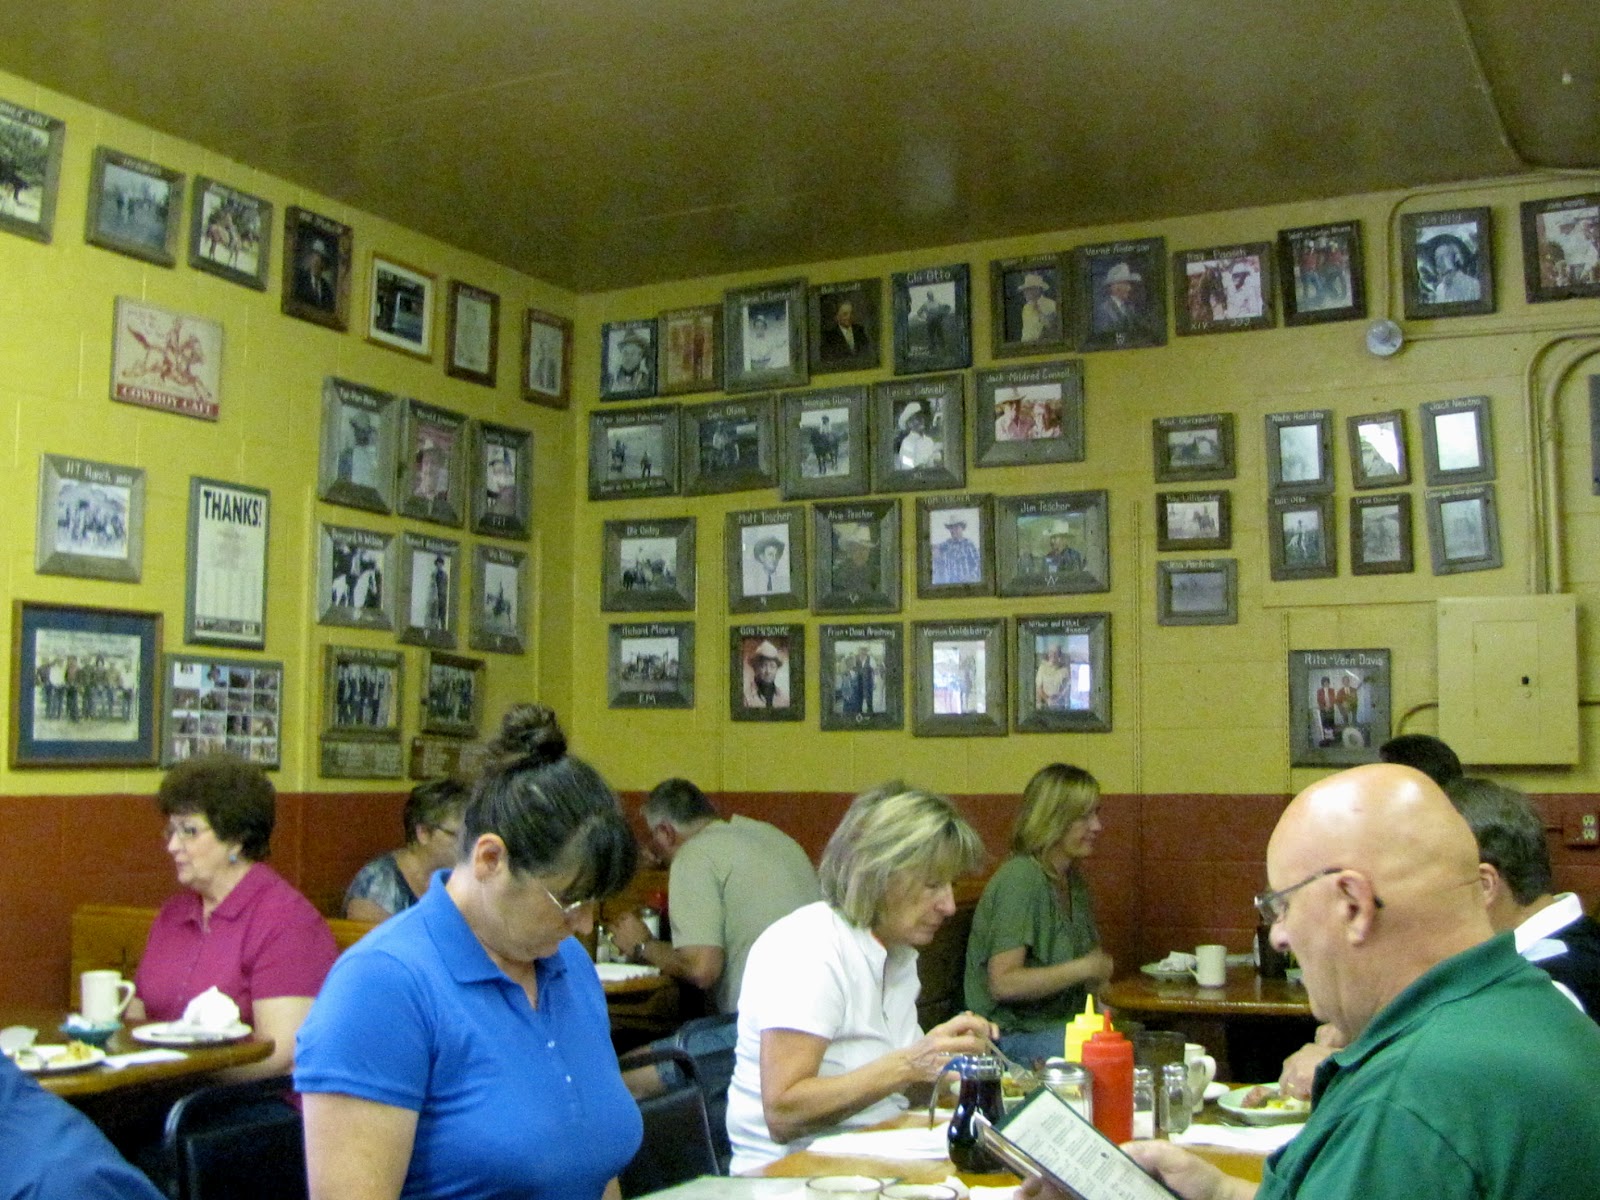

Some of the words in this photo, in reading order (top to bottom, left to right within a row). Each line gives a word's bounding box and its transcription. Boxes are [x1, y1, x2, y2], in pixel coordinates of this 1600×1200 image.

[203, 490, 262, 528] THANKS!
[1303, 652, 1327, 665] Rita
[1332, 652, 1357, 666] Vern
[1358, 652, 1384, 667] Davis
